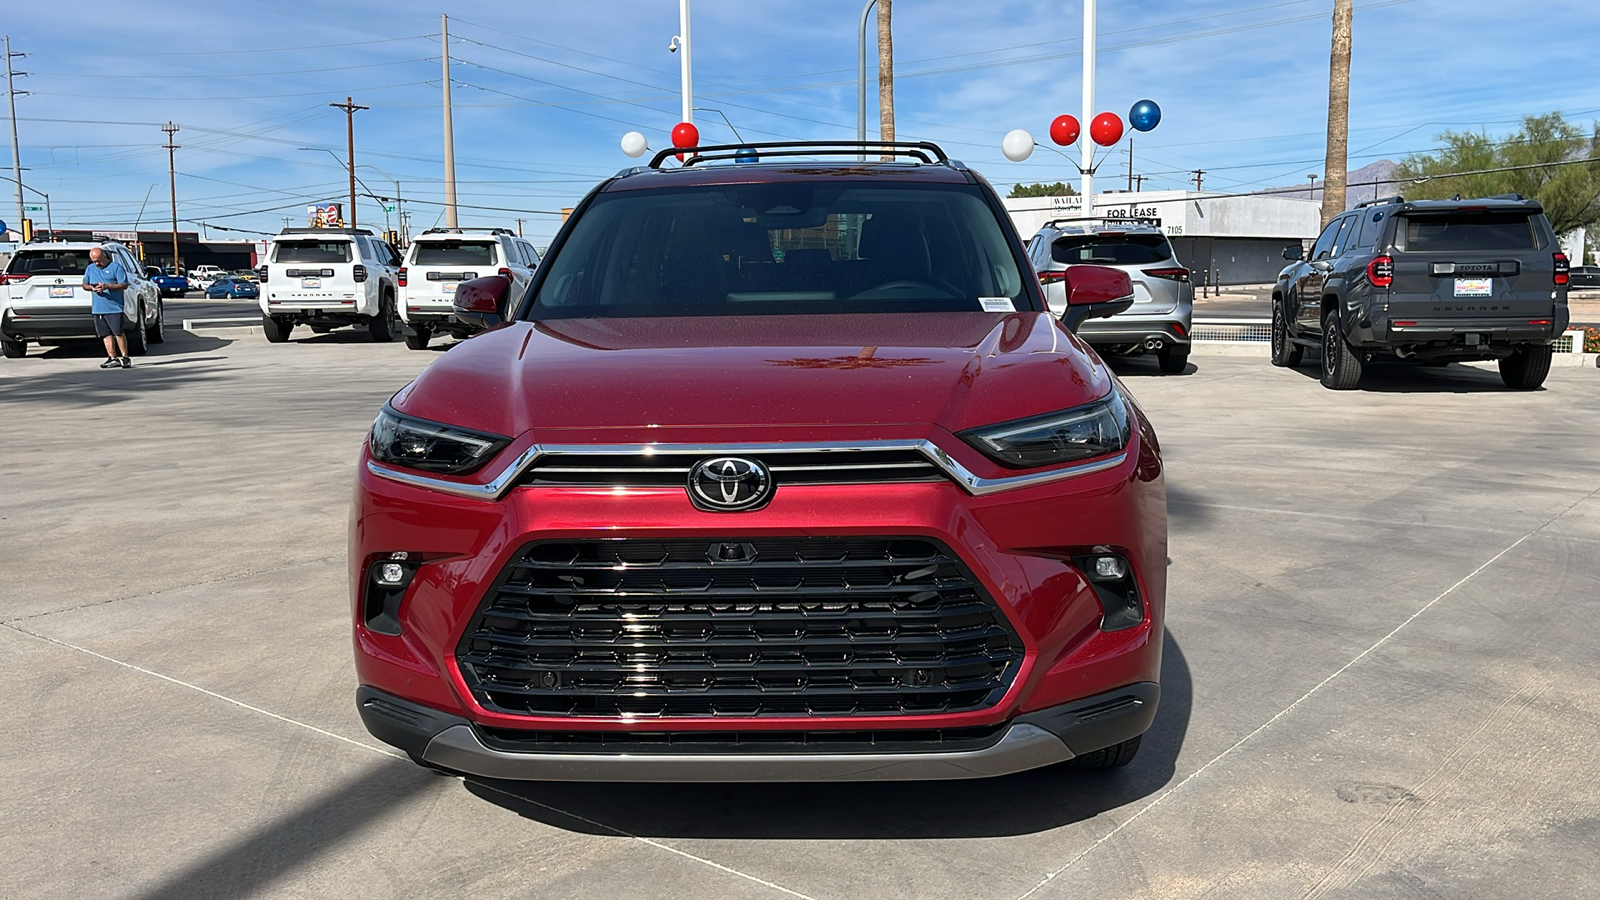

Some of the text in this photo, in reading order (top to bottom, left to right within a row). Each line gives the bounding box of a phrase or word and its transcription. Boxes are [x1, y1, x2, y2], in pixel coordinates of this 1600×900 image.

[1107, 207, 1157, 218] FOR LEASE
[1167, 225, 1183, 234] 7105
